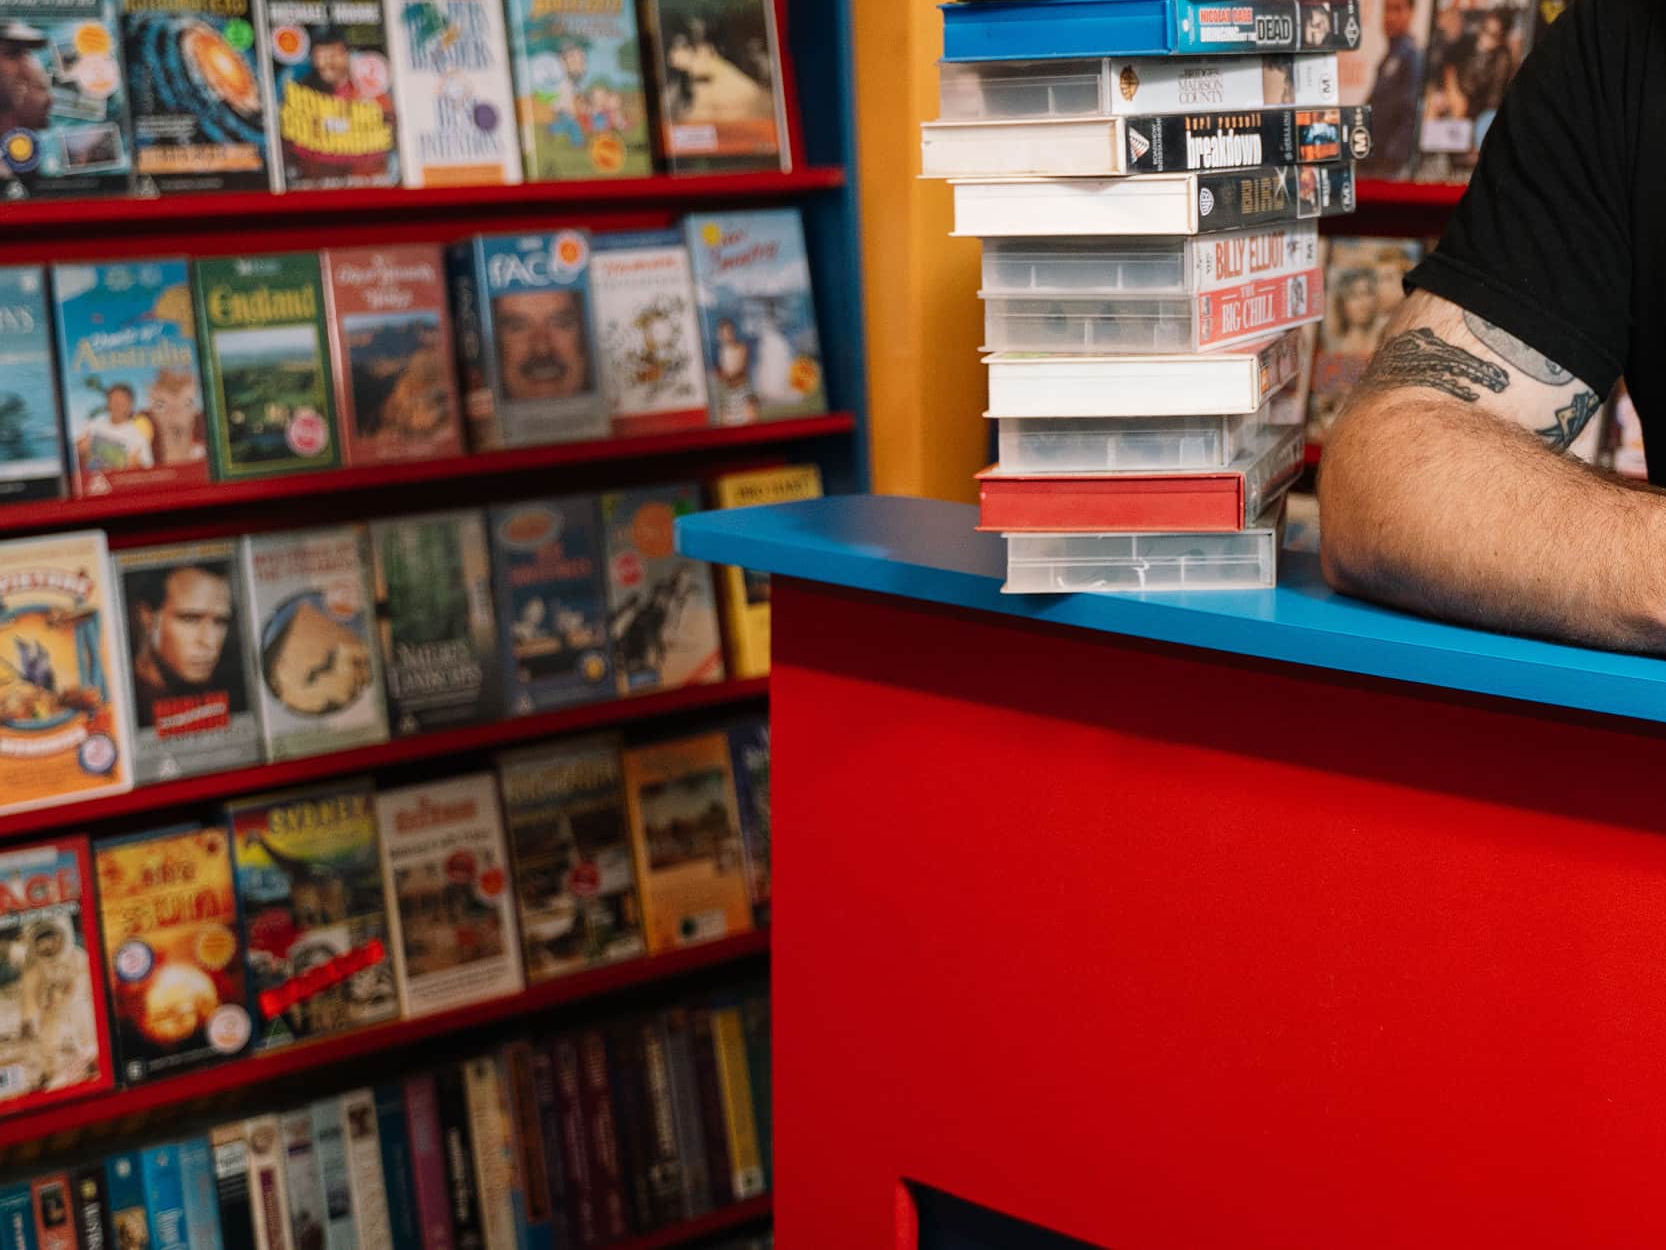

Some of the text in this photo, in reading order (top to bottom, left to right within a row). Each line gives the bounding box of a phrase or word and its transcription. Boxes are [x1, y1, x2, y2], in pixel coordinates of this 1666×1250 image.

[1257, 17, 1291, 41] DEAD
[1178, 79, 1224, 91] MADISON
[1178, 91, 1224, 103] COUNTY
[1186, 127, 1262, 169] breakdown
[1354, 132, 1367, 154] M
[1215, 230, 1285, 281] BILLY ELLIOT
[208, 284, 316, 326] England
[1221, 294, 1275, 334] BIG CHILL
